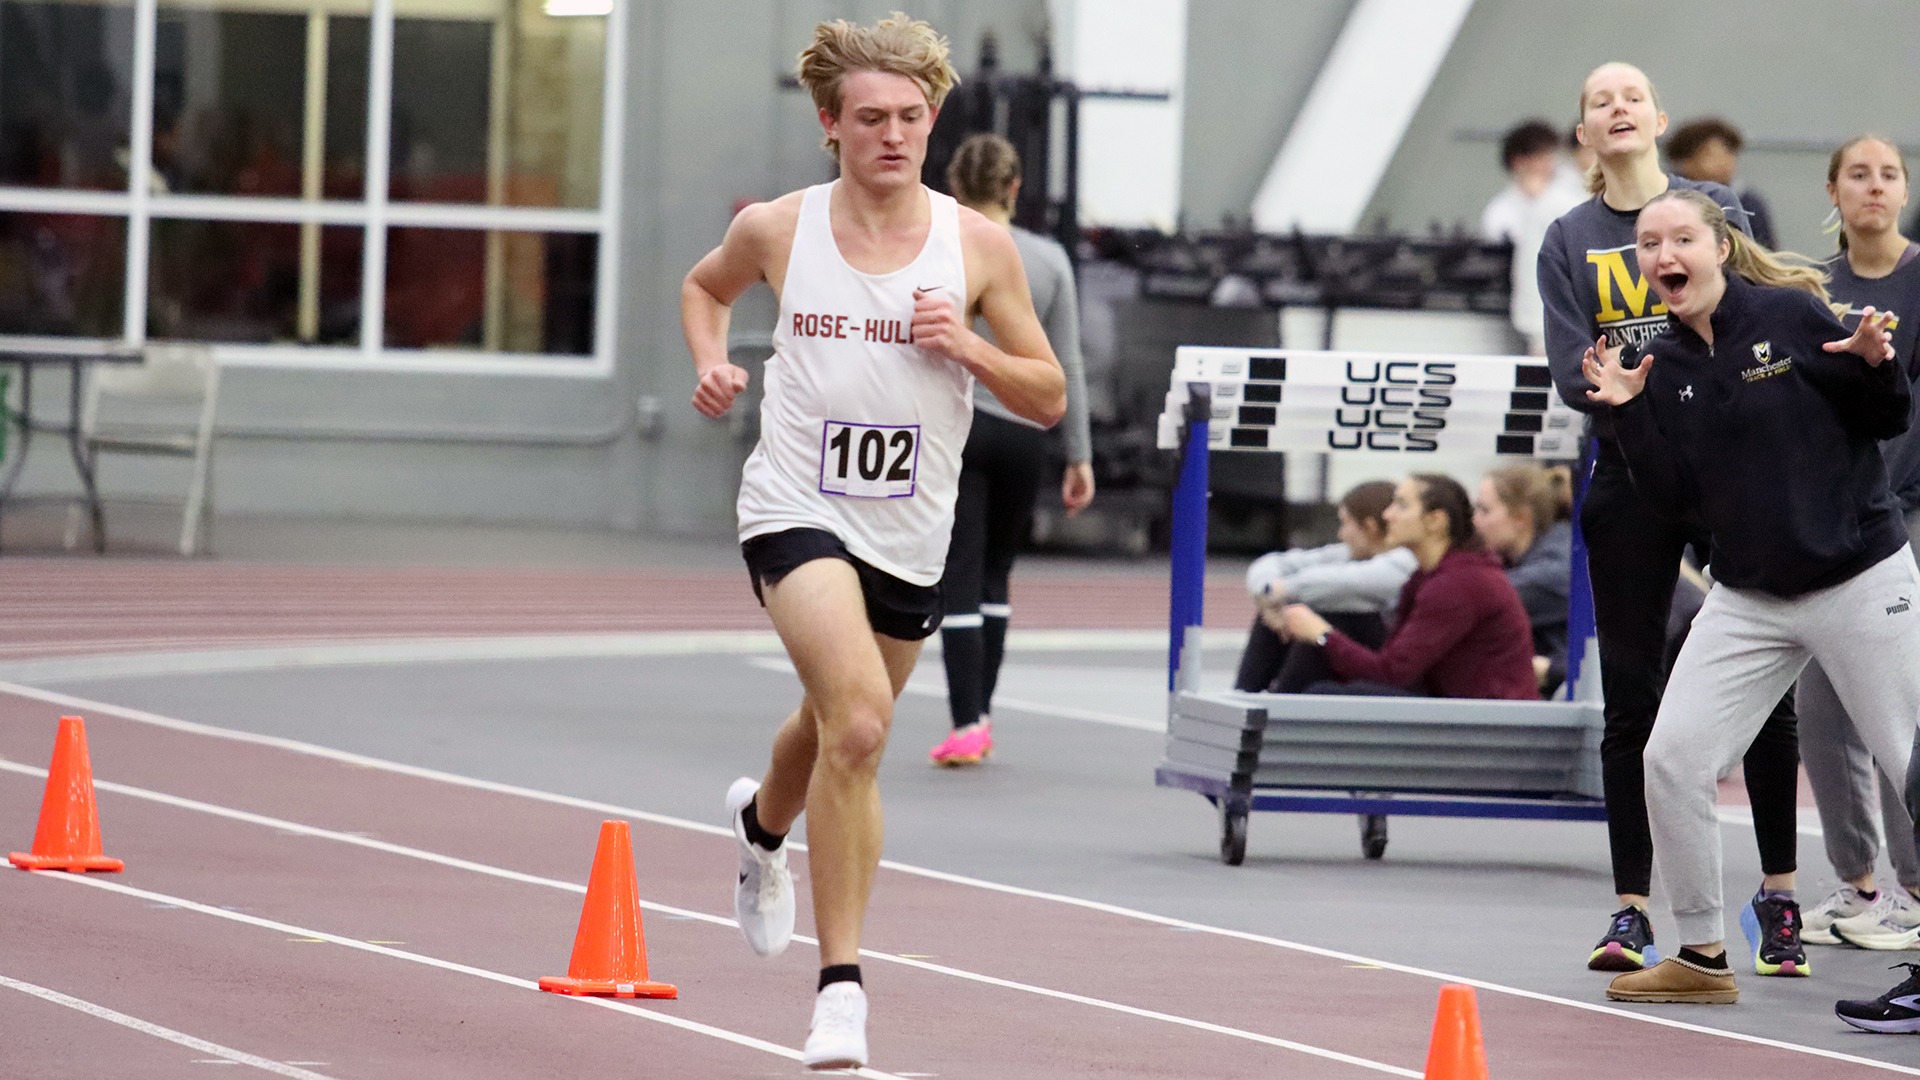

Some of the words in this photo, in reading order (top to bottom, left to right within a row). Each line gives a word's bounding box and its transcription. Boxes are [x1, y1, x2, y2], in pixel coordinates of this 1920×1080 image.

[793, 313, 914, 344] ROSE-HUL
[1347, 361, 1456, 385] UCS
[1741, 356, 1792, 379] Manchester
[1342, 387, 1451, 407] UCS
[1336, 409, 1446, 429] UCS
[1329, 430, 1438, 451] UCS
[830, 427, 913, 481] 102
